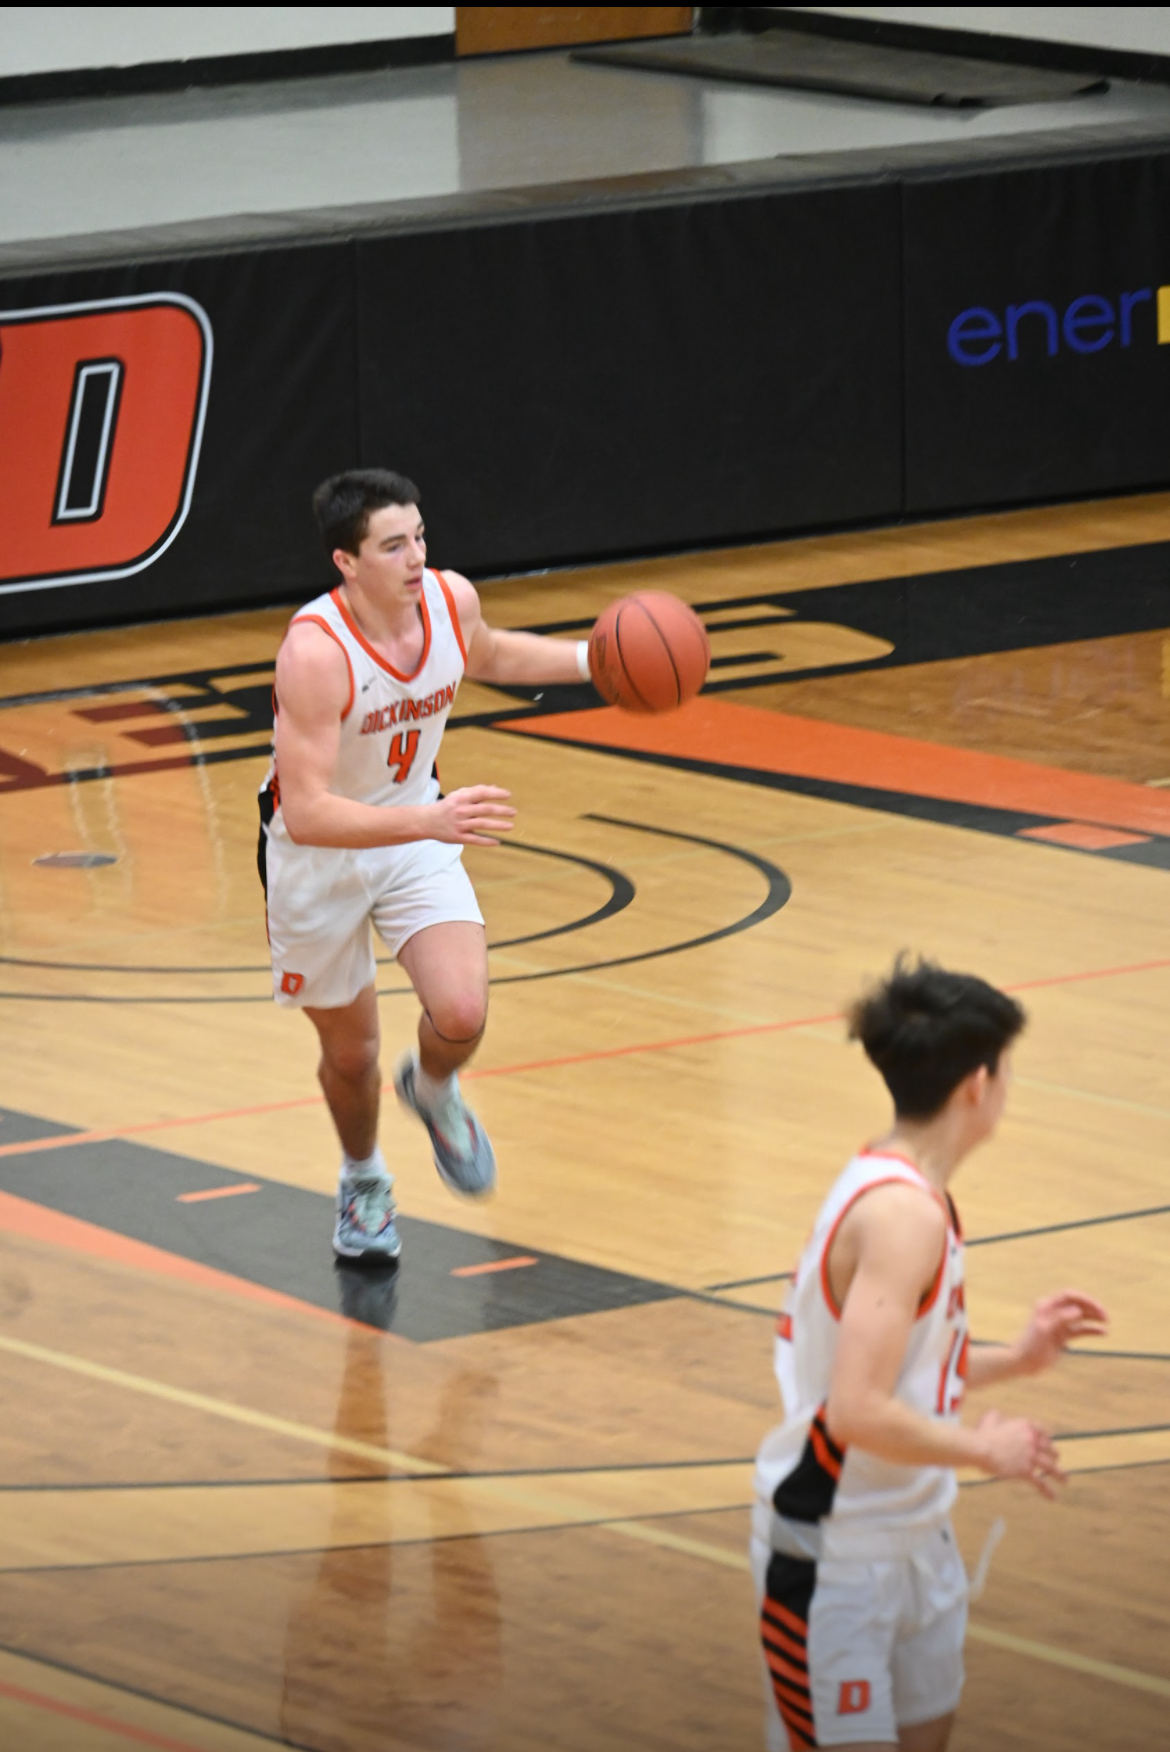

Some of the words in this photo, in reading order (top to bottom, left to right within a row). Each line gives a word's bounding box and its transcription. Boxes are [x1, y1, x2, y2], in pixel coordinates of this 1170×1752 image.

[0, 291, 213, 594] D
[359, 680, 455, 736] DICKINSON
[387, 729, 421, 784] 4
[280, 971, 306, 998] D
[836, 1679, 871, 1716] D
